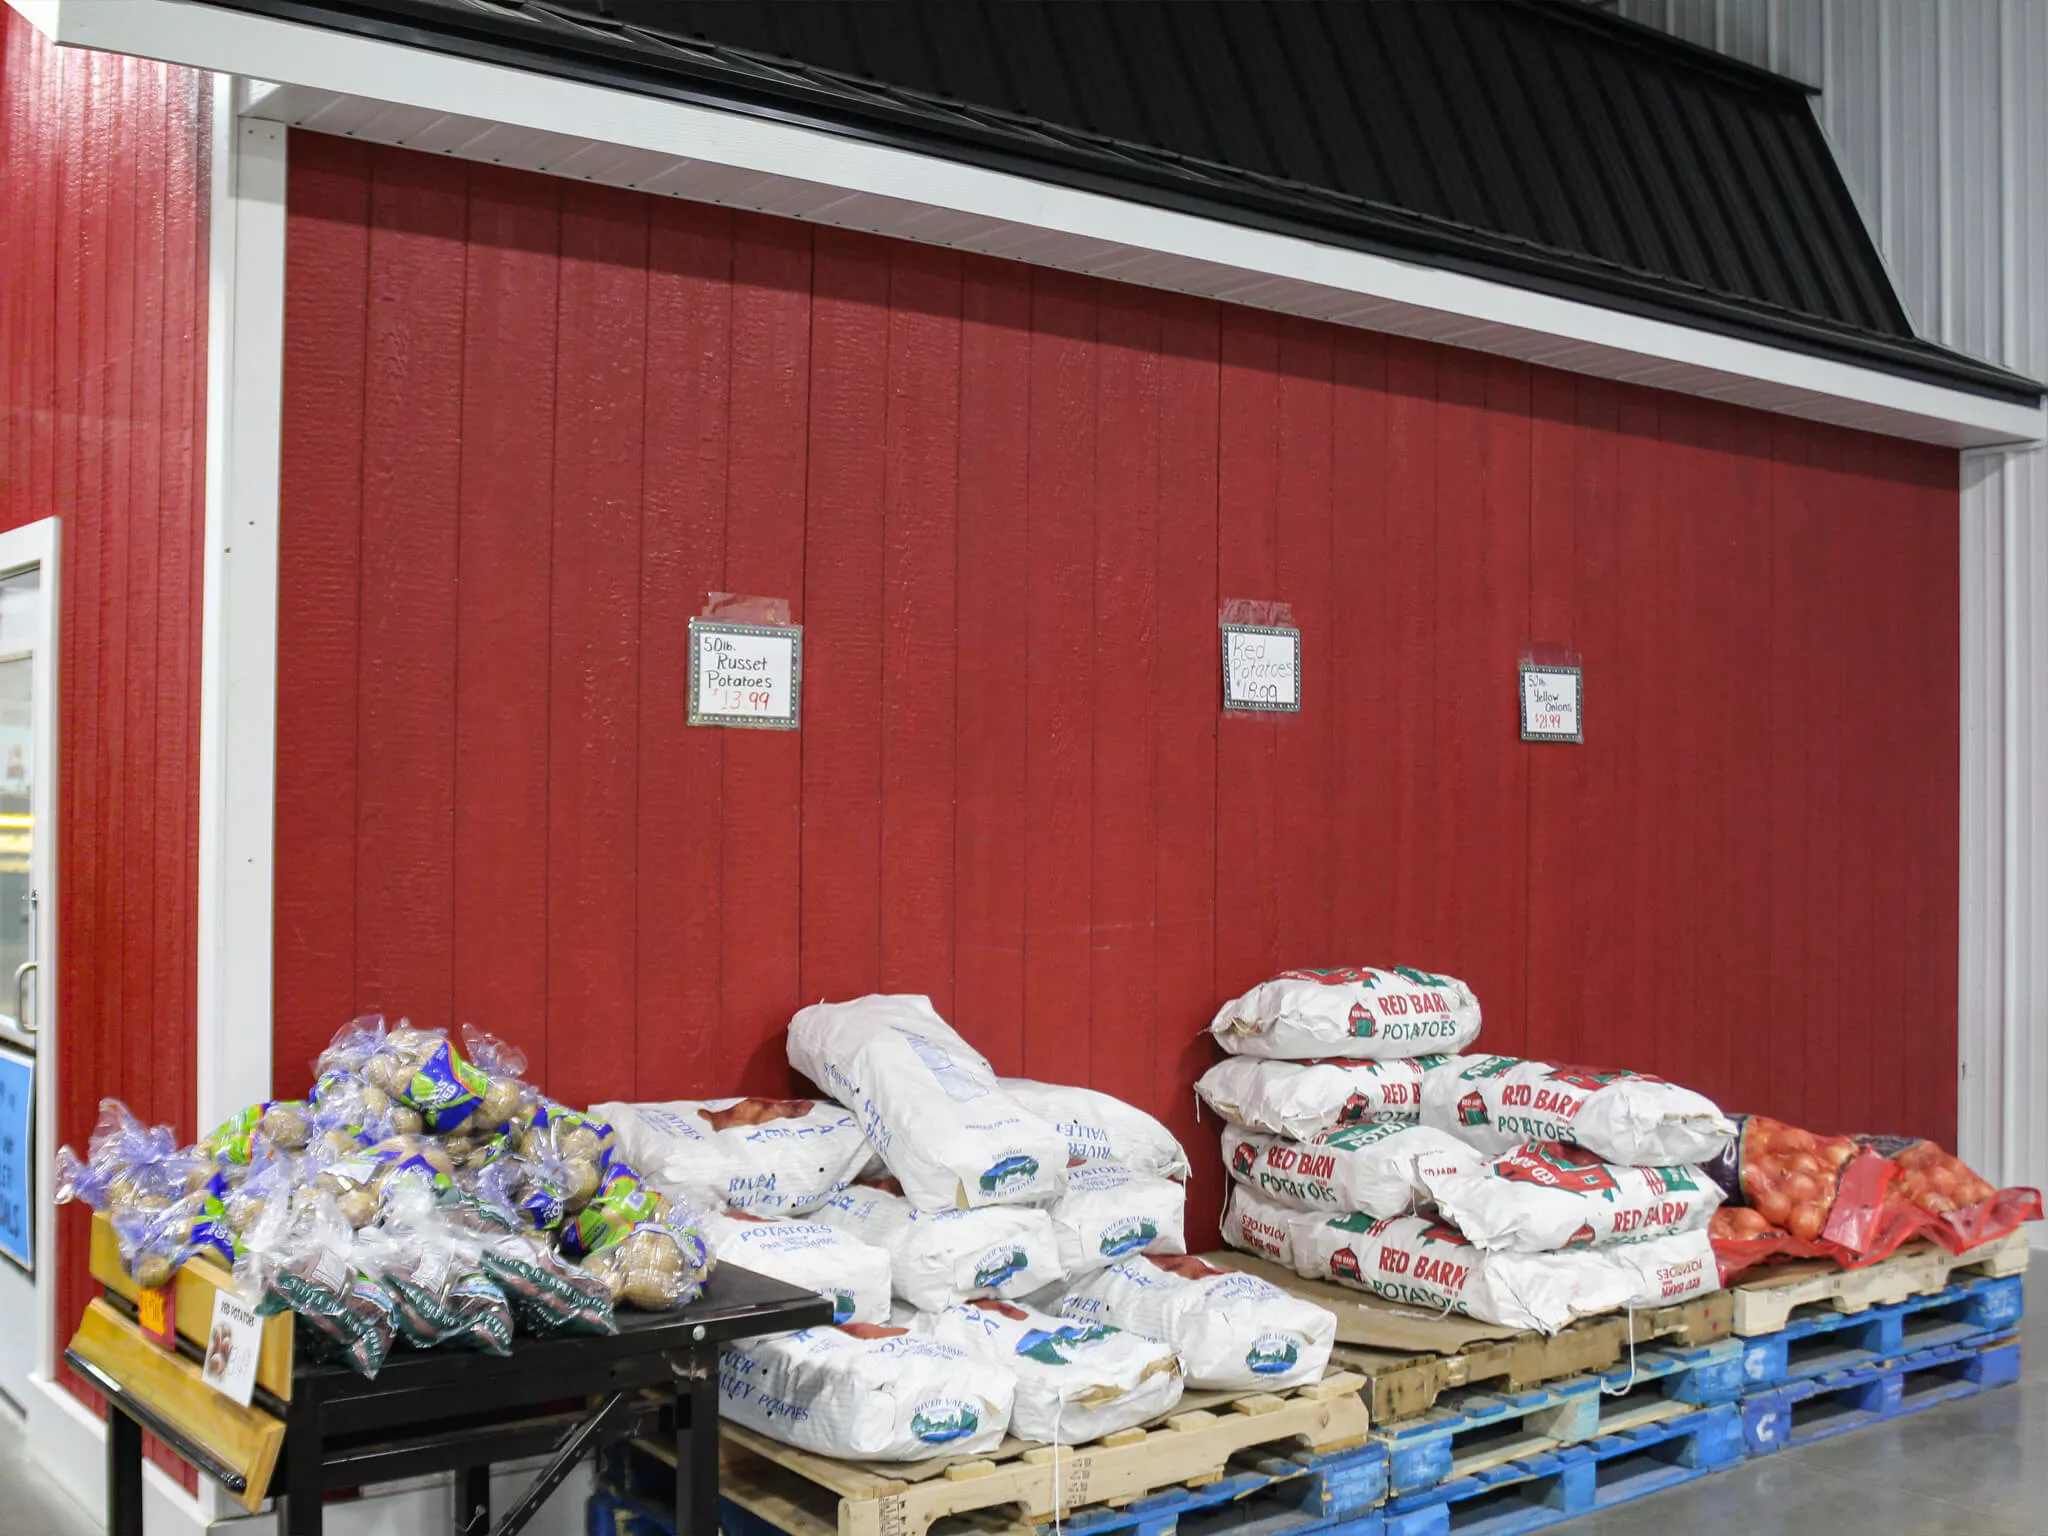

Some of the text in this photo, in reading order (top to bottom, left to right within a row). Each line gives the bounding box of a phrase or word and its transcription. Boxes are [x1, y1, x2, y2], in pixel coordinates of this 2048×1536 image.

[1233, 635, 1266, 661] Red
[716, 653, 768, 671] Russet
[1231, 657, 1293, 681] Potatoes
[705, 670, 773, 689] Potatoes
[1533, 688, 1560, 703] Yellow
[1377, 994, 1407, 1016] RED
[1382, 1020, 1456, 1041] POTATOES
[1381, 1083, 1408, 1105] RED
[1533, 1089, 1584, 1121] BARN
[1498, 1115, 1577, 1145] POTATOES
[1067, 1142, 1111, 1160] RIVER
[1267, 1145, 1297, 1170] RED
[728, 1174, 777, 1193] RIVER
[1260, 1172, 1337, 1202] POTATOES
[1242, 1214, 1287, 1243] POTATOES
[1611, 1208, 1643, 1234] RED
[740, 1224, 833, 1243] POTATOES
[1379, 1246, 1470, 1291] RED BARN
[1656, 1258, 1703, 1282] POTOES
[231, 1304, 256, 1328] POTATOES
[719, 1351, 756, 1376] VER
[719, 1373, 756, 1400] LLEY
